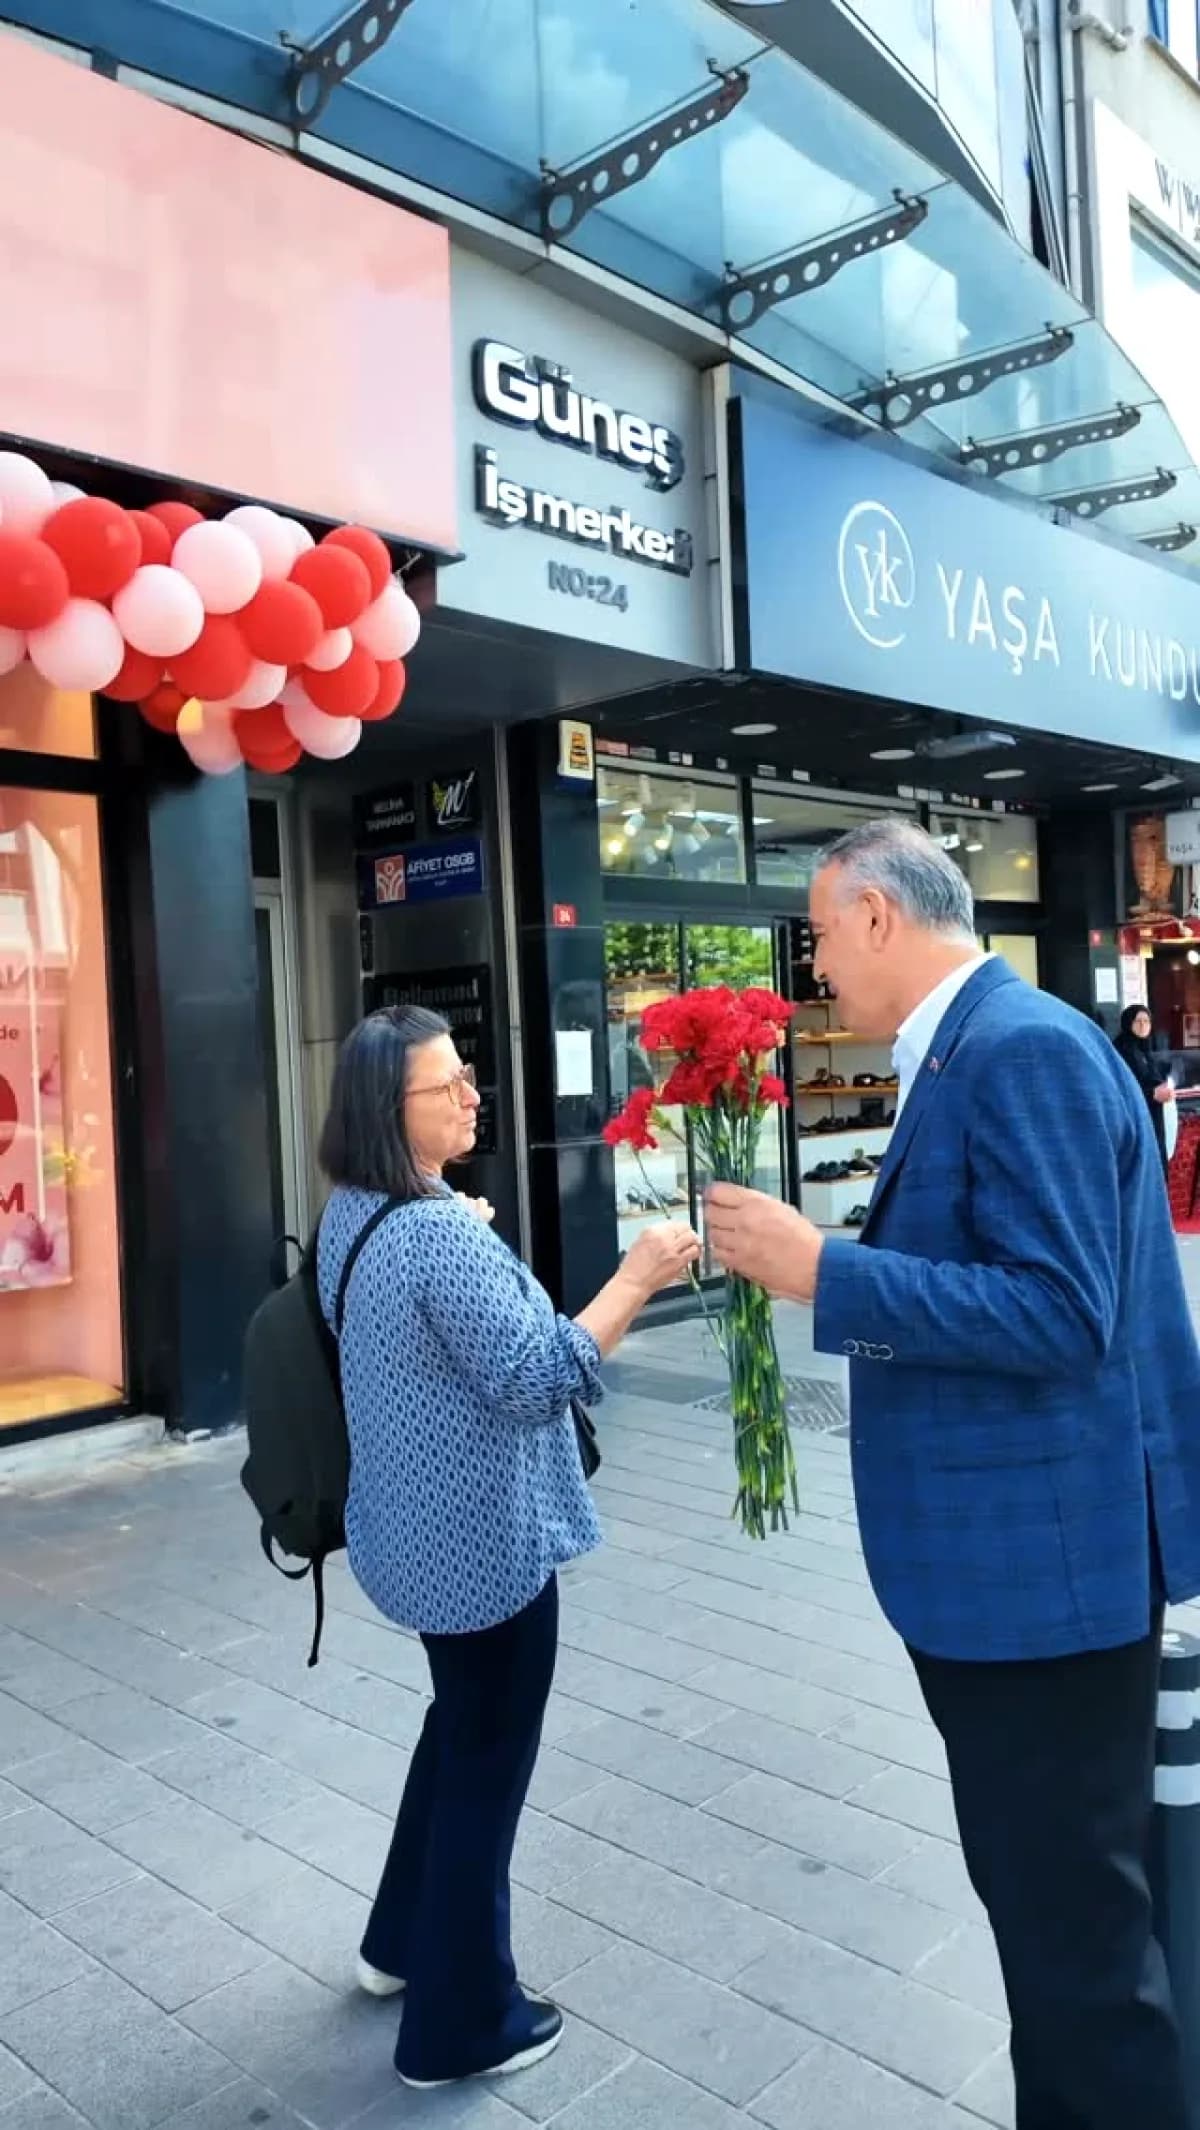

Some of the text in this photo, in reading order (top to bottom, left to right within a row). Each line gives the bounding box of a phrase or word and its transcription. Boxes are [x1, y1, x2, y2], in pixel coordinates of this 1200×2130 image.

[473, 339, 685, 492] Güneş
[547, 560, 629, 613] NO:24
[936, 561, 1061, 676] YAŞA
